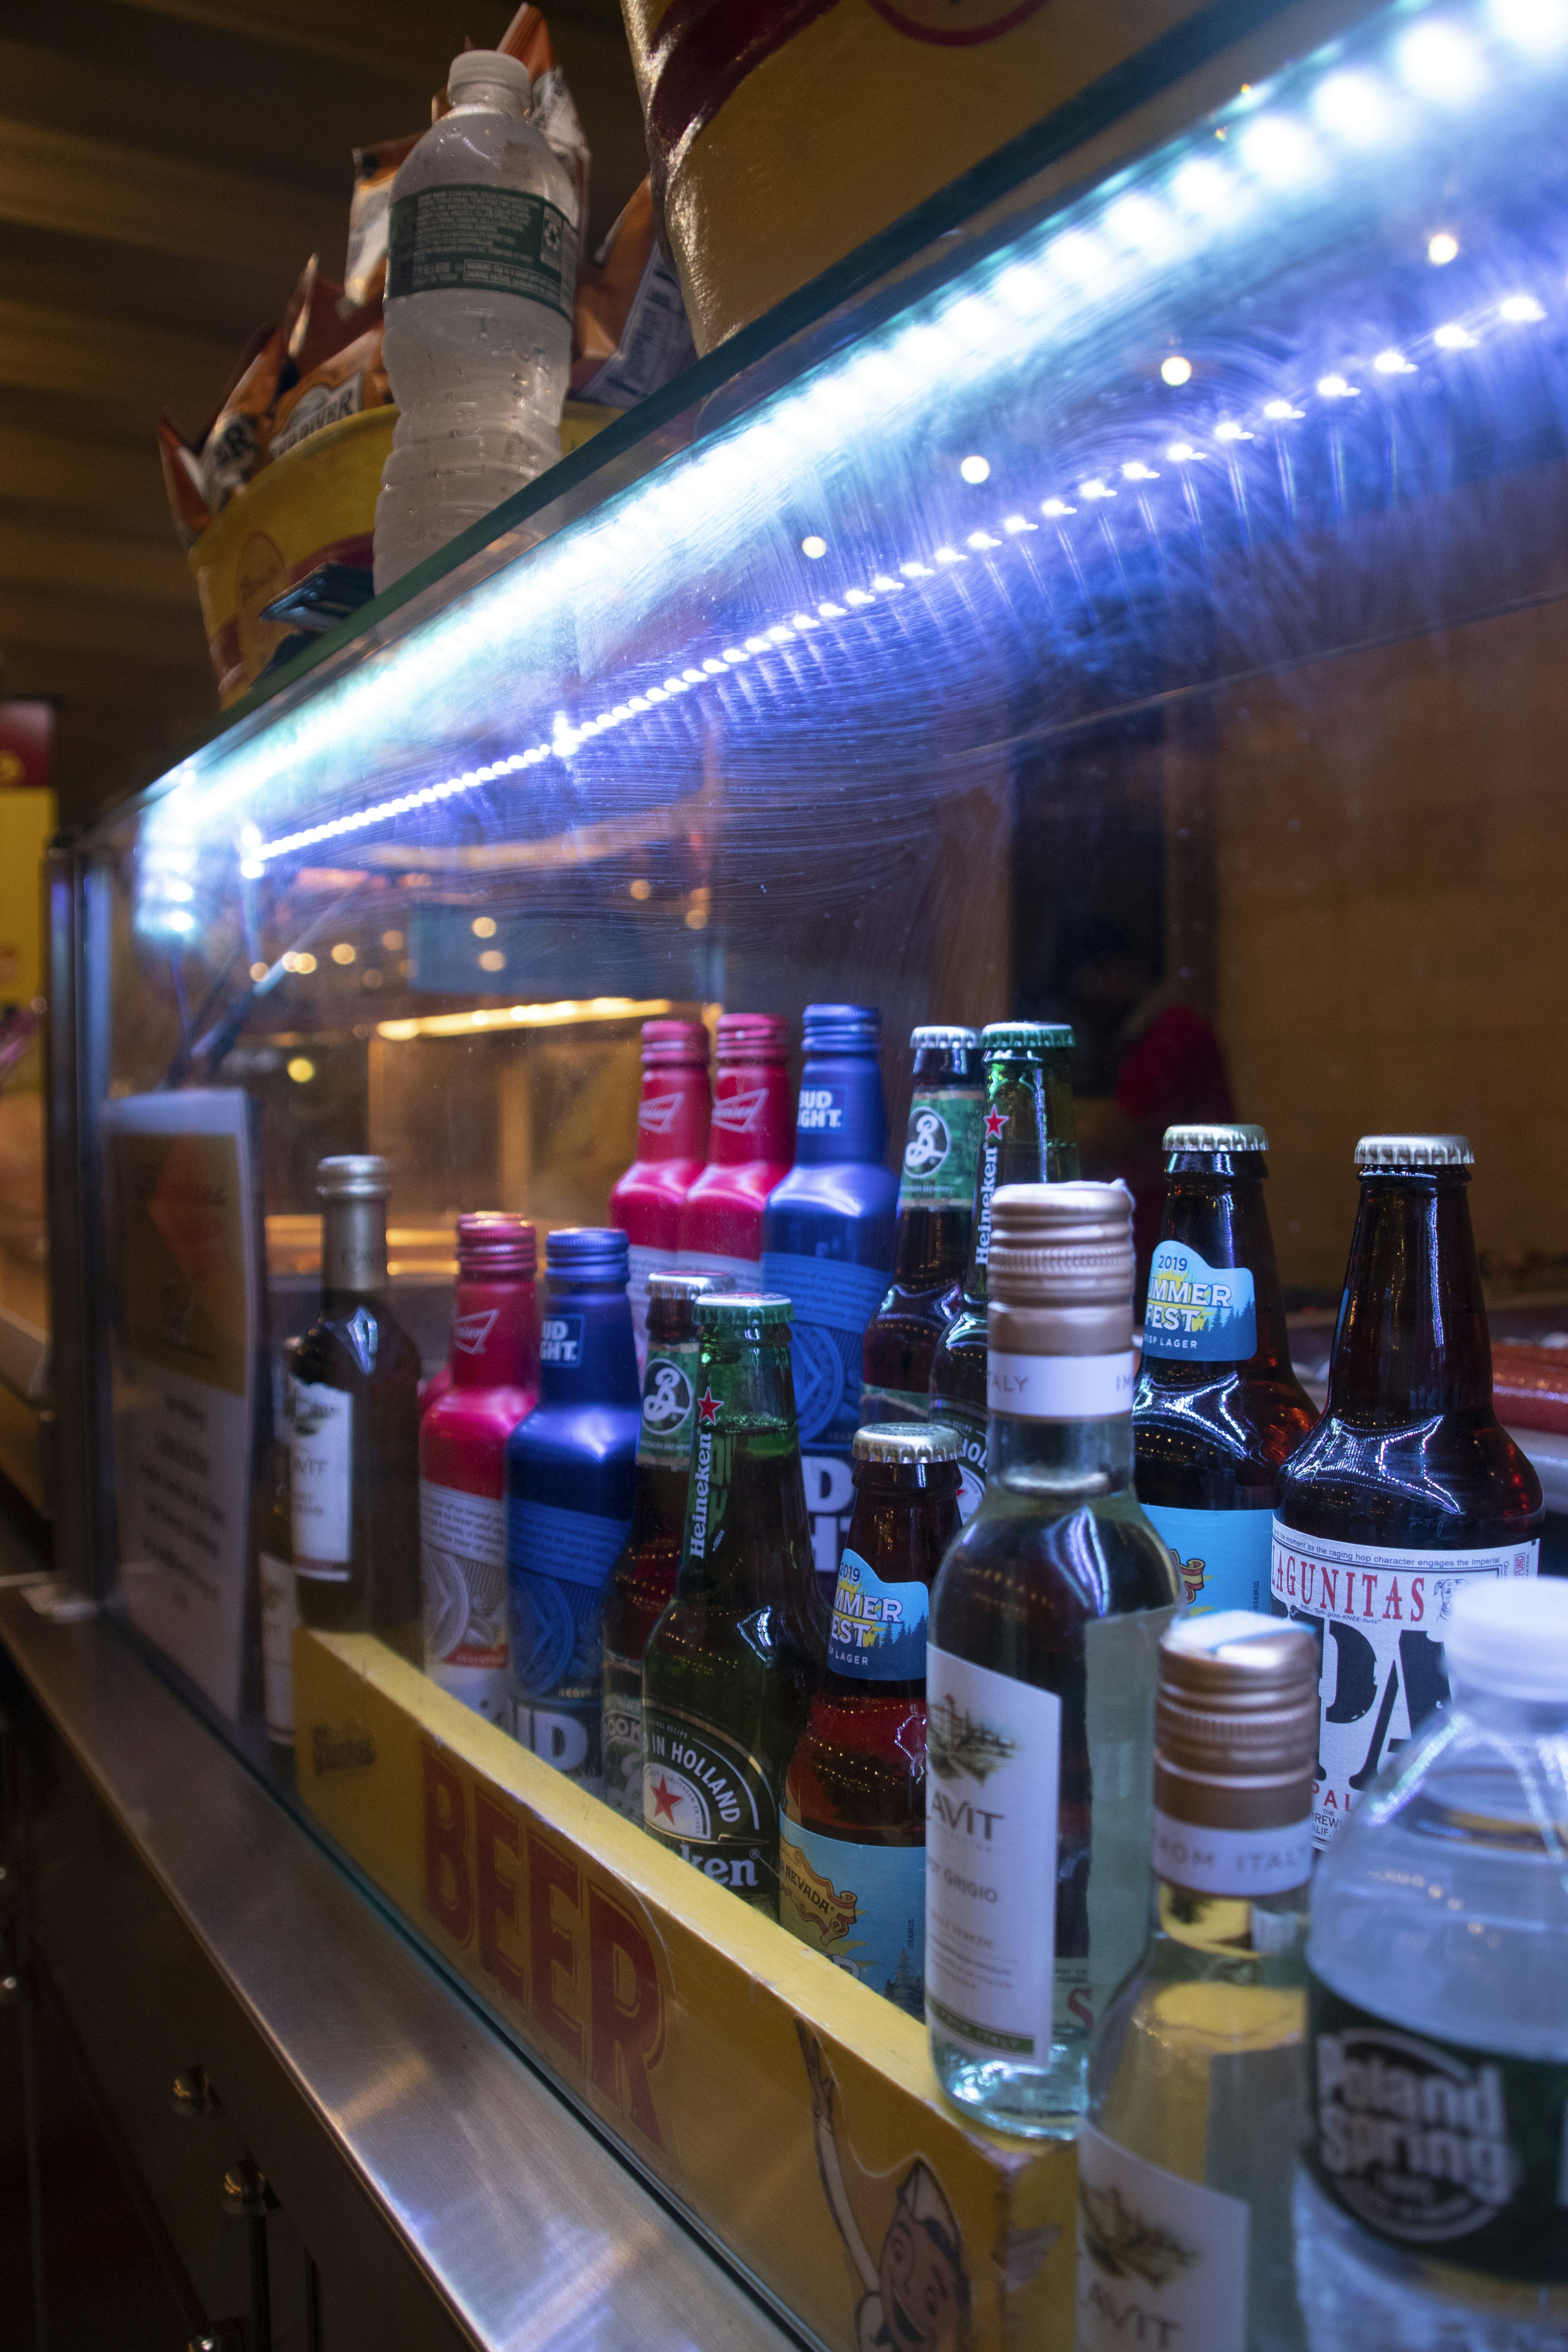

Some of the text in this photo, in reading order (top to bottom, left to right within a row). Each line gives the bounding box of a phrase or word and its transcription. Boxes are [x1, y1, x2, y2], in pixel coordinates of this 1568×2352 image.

[975, 1147, 998, 1265] Heineken
[1158, 1256, 1187, 1271] 2019
[1147, 1278, 1232, 1307] UMMER
[1160, 1336, 1198, 1349] LAGER
[690, 1434, 711, 1559] Heineken
[1286, 1536, 1306, 1548] moment
[1317, 1546, 1327, 1554] the
[1329, 1550, 1353, 1561] raging
[1356, 1553, 1371, 1564] hop
[1374, 1555, 1415, 1567] character
[1417, 1559, 1454, 1570] engages
[1472, 1557, 1500, 1568] Imperial
[840, 1563, 860, 1583] 2019
[1271, 1544, 1425, 1622] LAGUNITAS
[835, 1590, 902, 1622] MMER
[831, 1617, 871, 1648] EST
[835, 1649, 869, 1666] LAGER
[666, 1725, 688, 1740] RECIPE
[652, 1734, 741, 1823] IN HOLLAND
[932, 1790, 1005, 1841] AVIT
[1313, 1825, 1331, 1838] ALIF.
[786, 1867, 828, 1913] NEVADA
[421, 1743, 666, 2154] BEER
